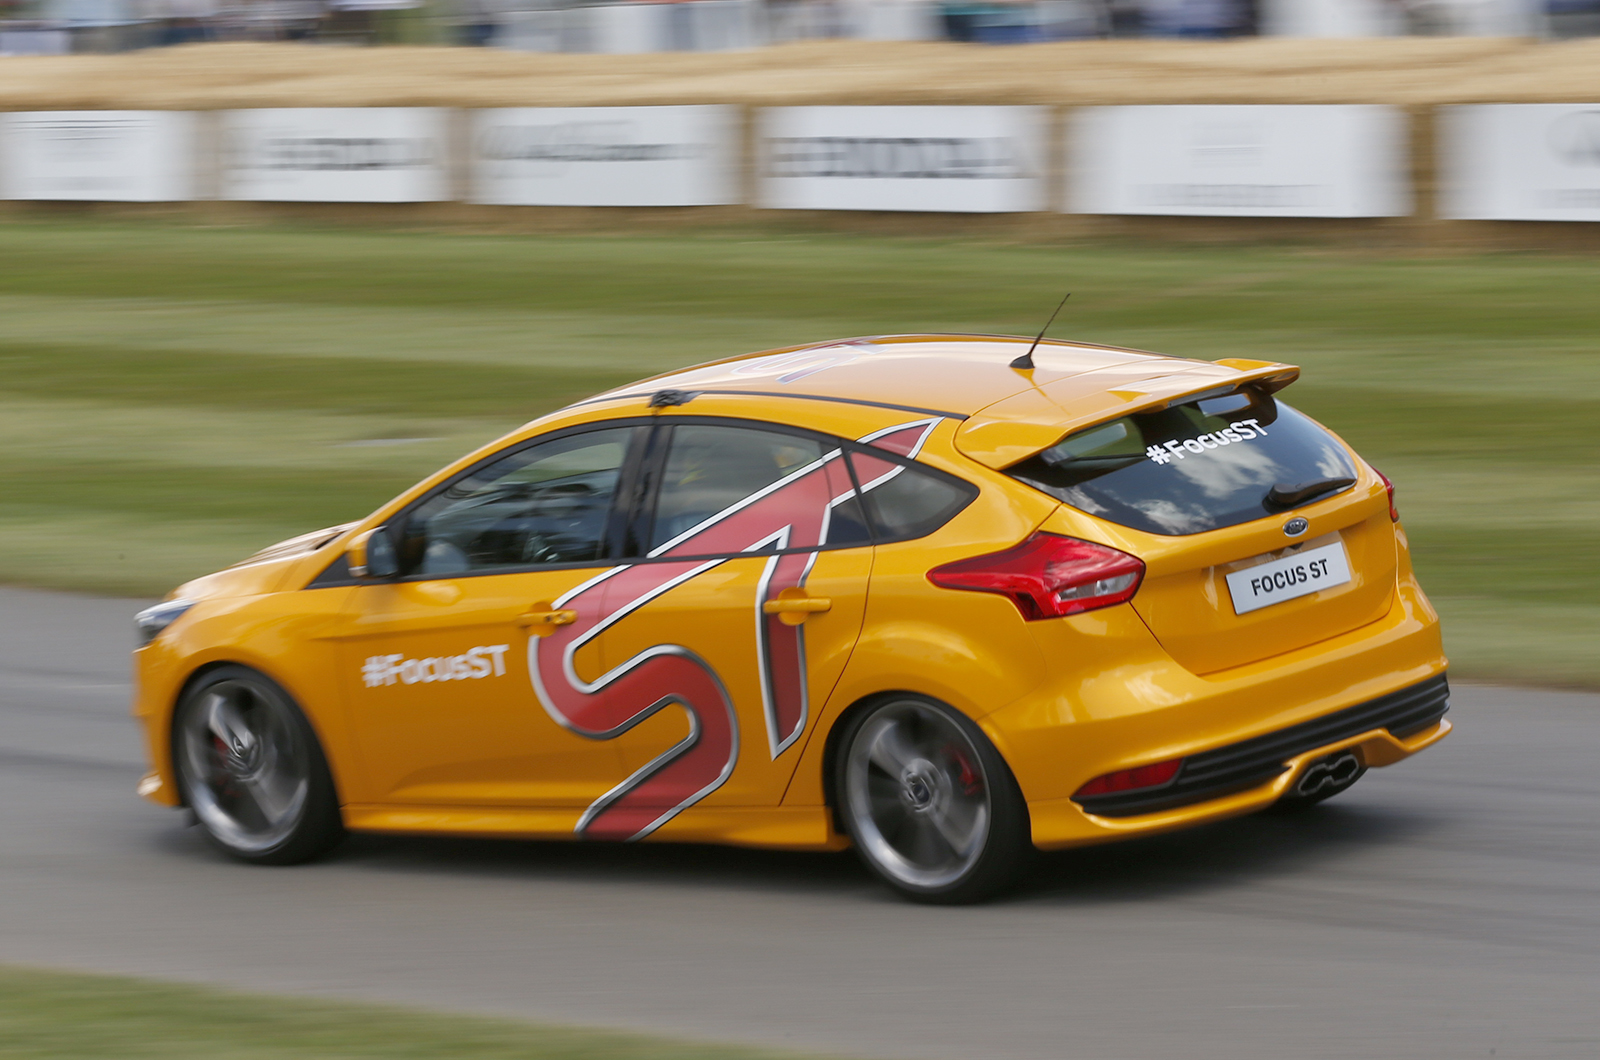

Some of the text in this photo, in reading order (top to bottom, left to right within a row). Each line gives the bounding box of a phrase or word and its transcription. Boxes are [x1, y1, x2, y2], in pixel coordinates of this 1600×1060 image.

[528, 417, 944, 841] ST
[1250, 558, 1328, 596] FOCUS ST
